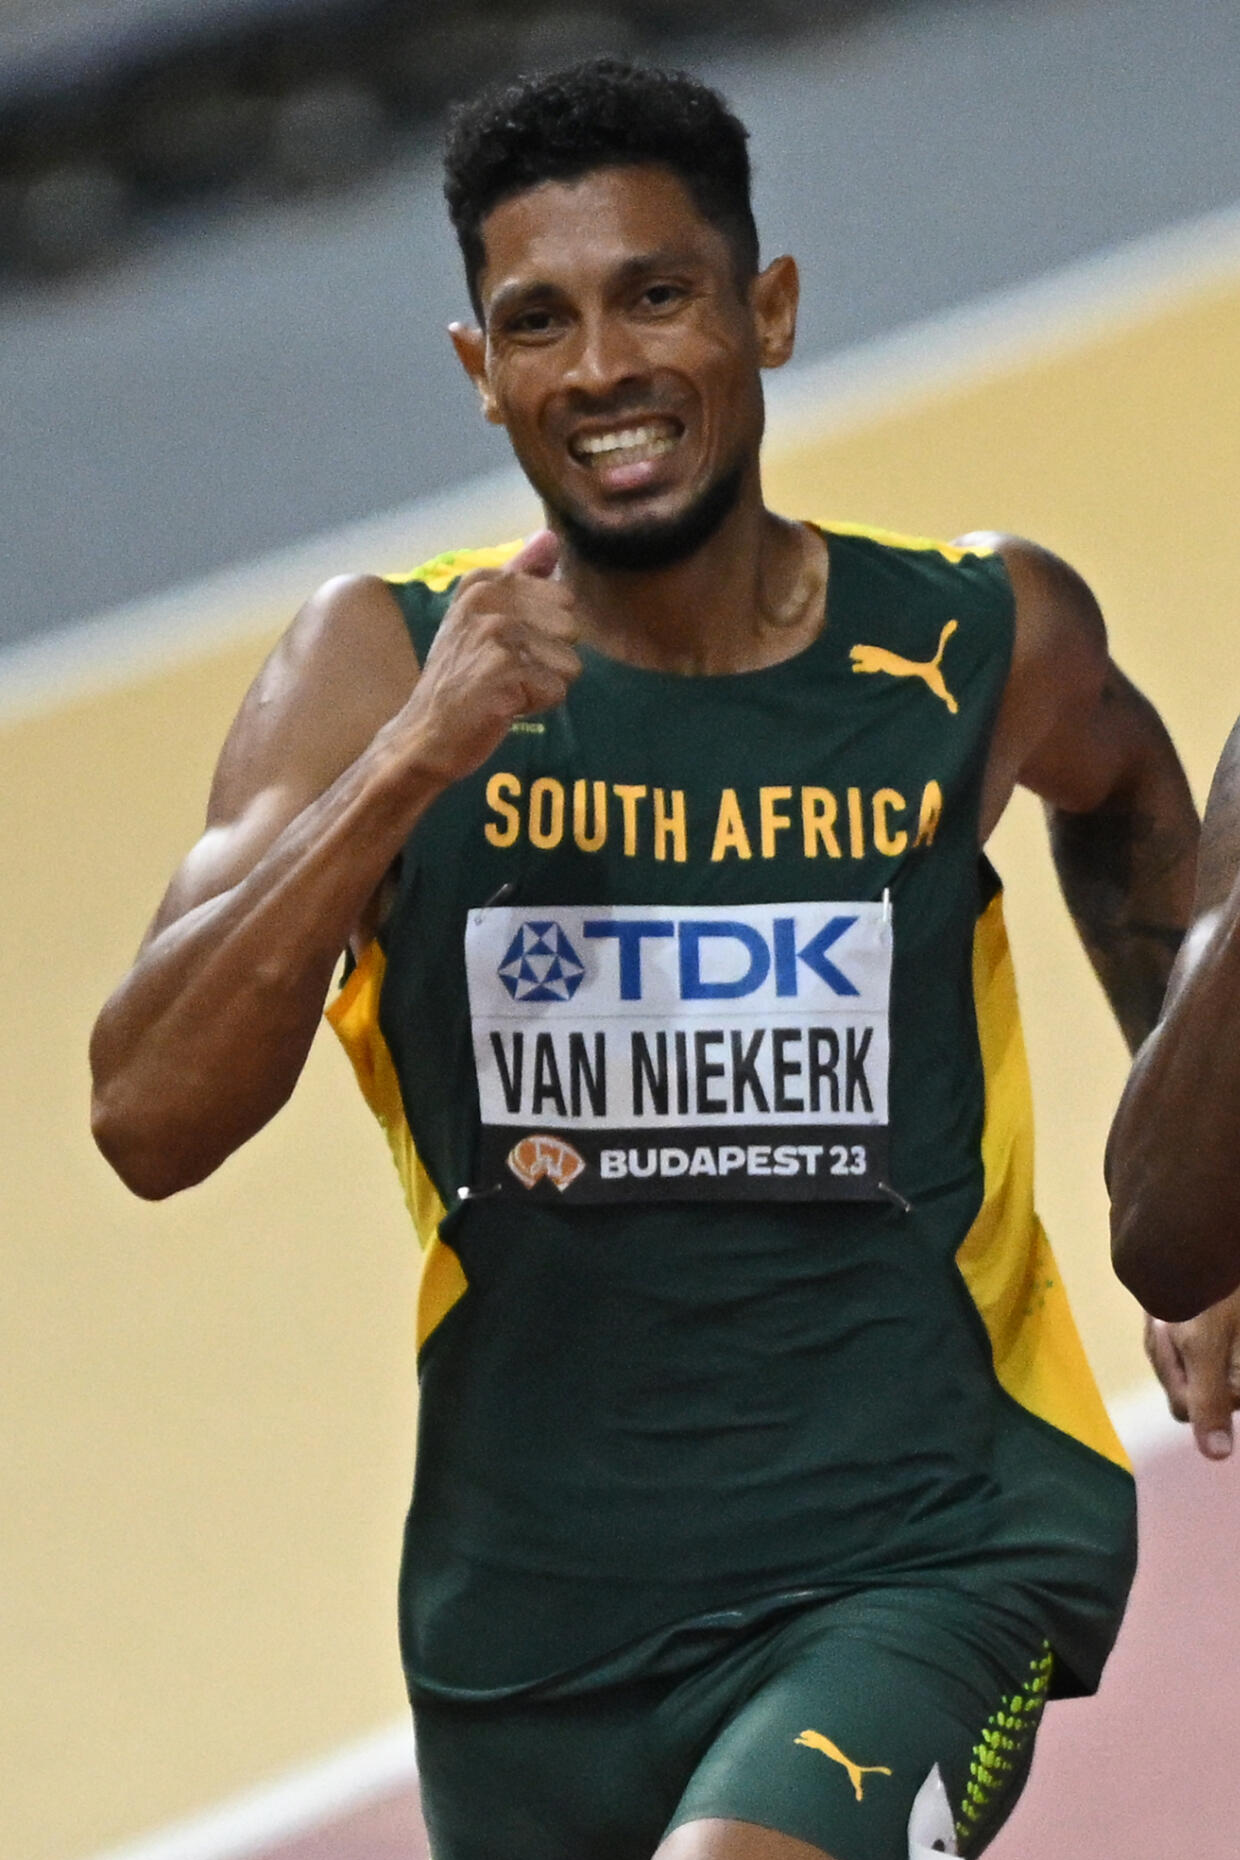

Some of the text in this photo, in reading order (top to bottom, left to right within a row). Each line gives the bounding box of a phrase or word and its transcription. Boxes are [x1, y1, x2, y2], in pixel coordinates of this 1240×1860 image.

[484, 772, 941, 862] SOUTH AFRICA
[583, 915, 862, 1001] TDK
[490, 1026, 874, 1117] VAN NIEKERK
[600, 1144, 867, 1178] BUDAPEST 23
